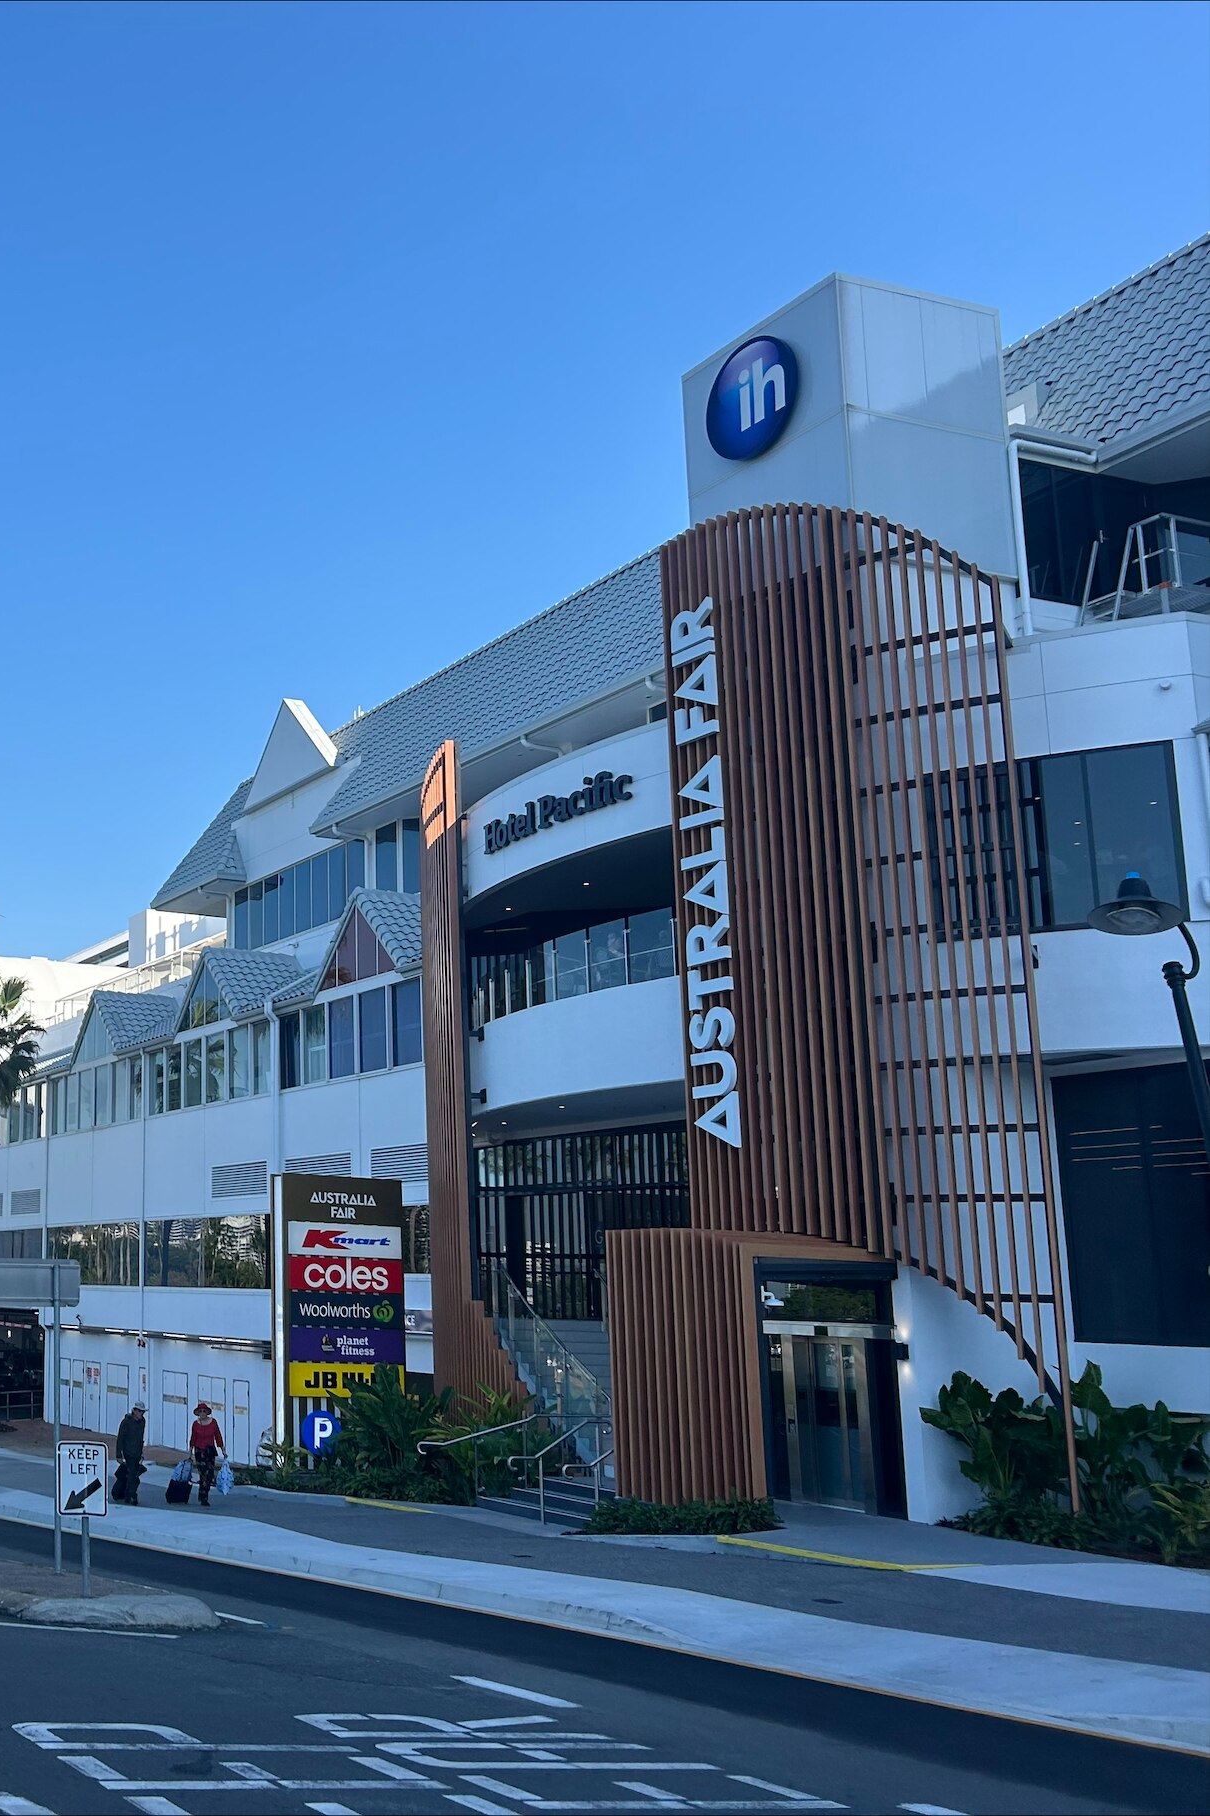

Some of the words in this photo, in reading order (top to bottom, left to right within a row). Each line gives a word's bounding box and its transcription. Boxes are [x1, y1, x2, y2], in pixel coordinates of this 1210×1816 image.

[738, 357, 786, 433] ih
[670, 596, 721, 748] FAIR
[483, 801, 538, 855] Hotel
[537, 770, 634, 830] Pacific
[677, 754, 743, 1149] AUSTRALIA
[310, 1191, 377, 1206] AUSTRALIA
[330, 1206, 357, 1219] FAIR
[302, 1229, 391, 1251] Kmart
[304, 1257, 389, 1291] coles
[299, 1302, 371, 1319] Woolworths
[336, 1335, 369, 1347] planet
[341, 1345, 375, 1356] fitness
[304, 1371, 338, 1389] JB
[314, 1417, 333, 1450] P
[68, 1448, 99, 1460] KEEP
[70, 1463, 98, 1475] LEFT
